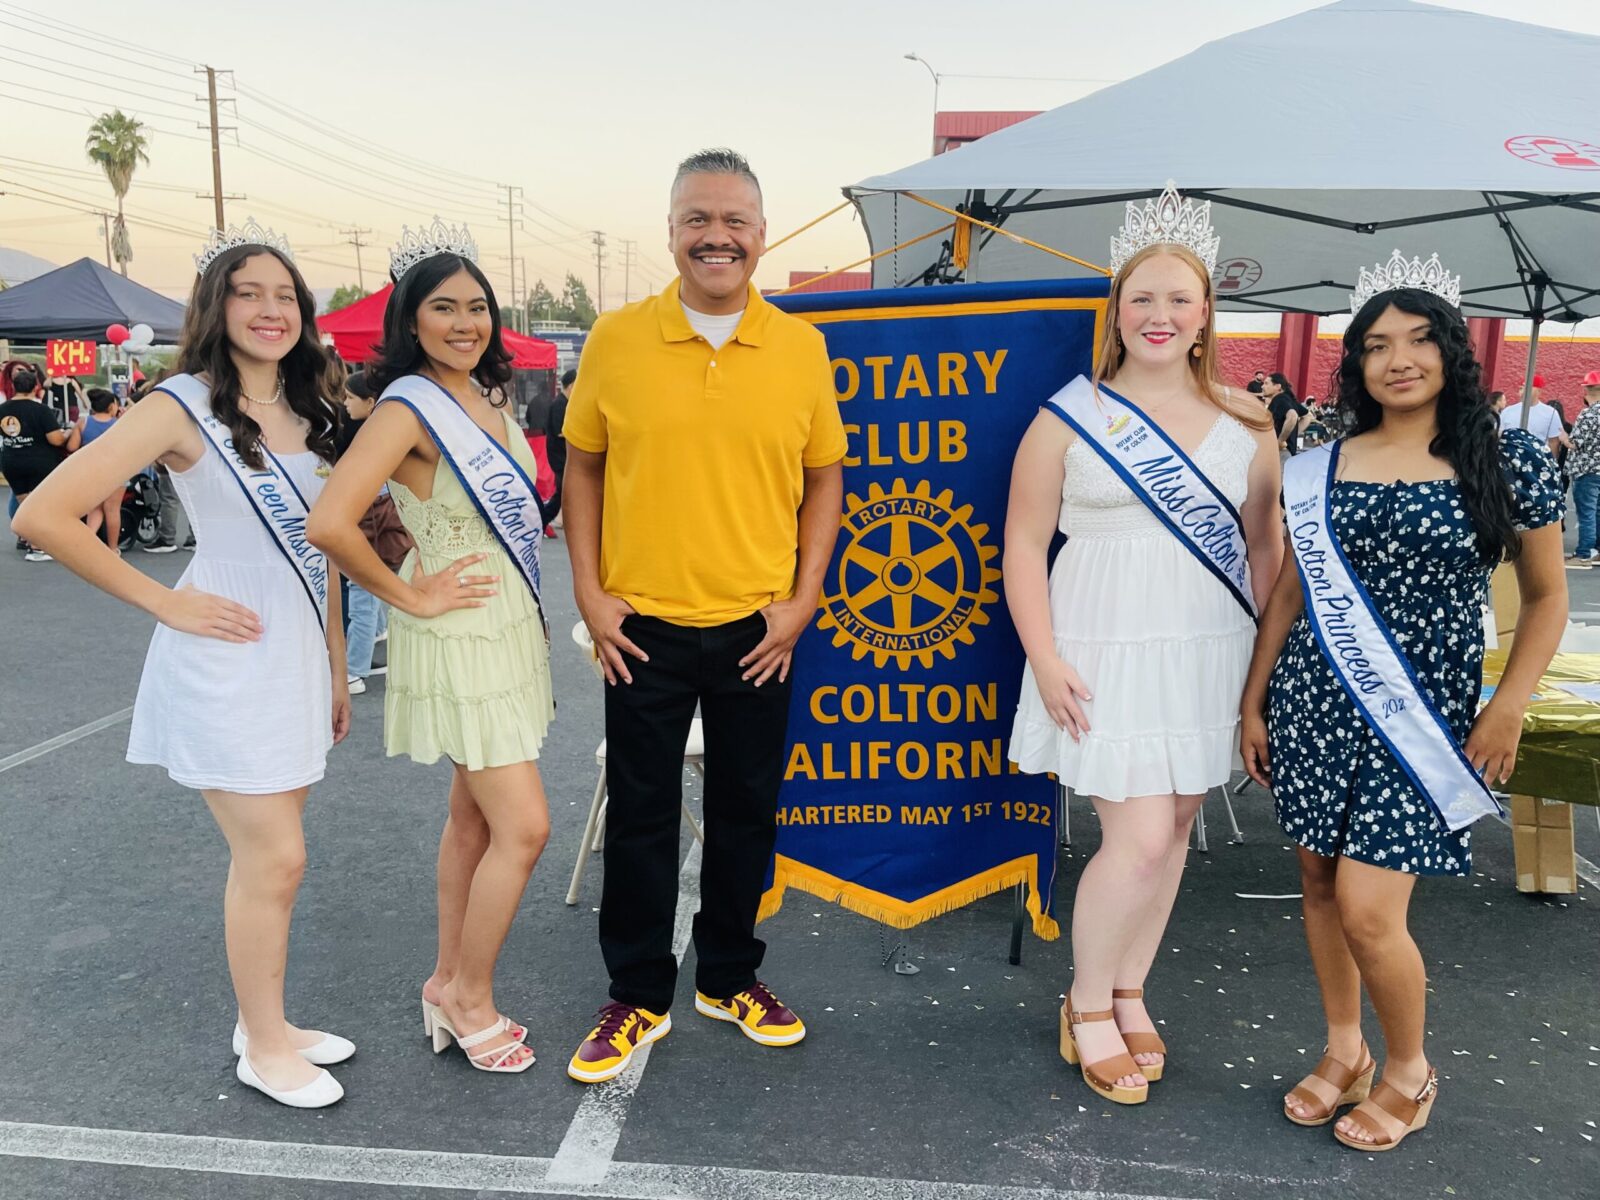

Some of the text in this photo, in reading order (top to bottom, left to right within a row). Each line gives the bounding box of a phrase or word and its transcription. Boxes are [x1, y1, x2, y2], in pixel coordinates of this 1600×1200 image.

[830, 349, 1009, 402] OTARY
[842, 420, 968, 467] CLUB
[482, 472, 527, 539] Colton
[858, 499, 942, 525] ROTARY
[1132, 455, 1194, 512] Miss
[1182, 504, 1239, 572] Colton
[249, 466, 328, 604] Teen Miss Colton
[835, 605, 972, 650] INTERNATIONAL
[1293, 521, 1332, 596] Colton
[1317, 594, 1384, 694] Princess
[809, 682, 997, 724] COLTON
[784, 739, 1055, 780] ALIFORN
[776, 801, 1051, 826] HARTERED MAY 1ST 1922
